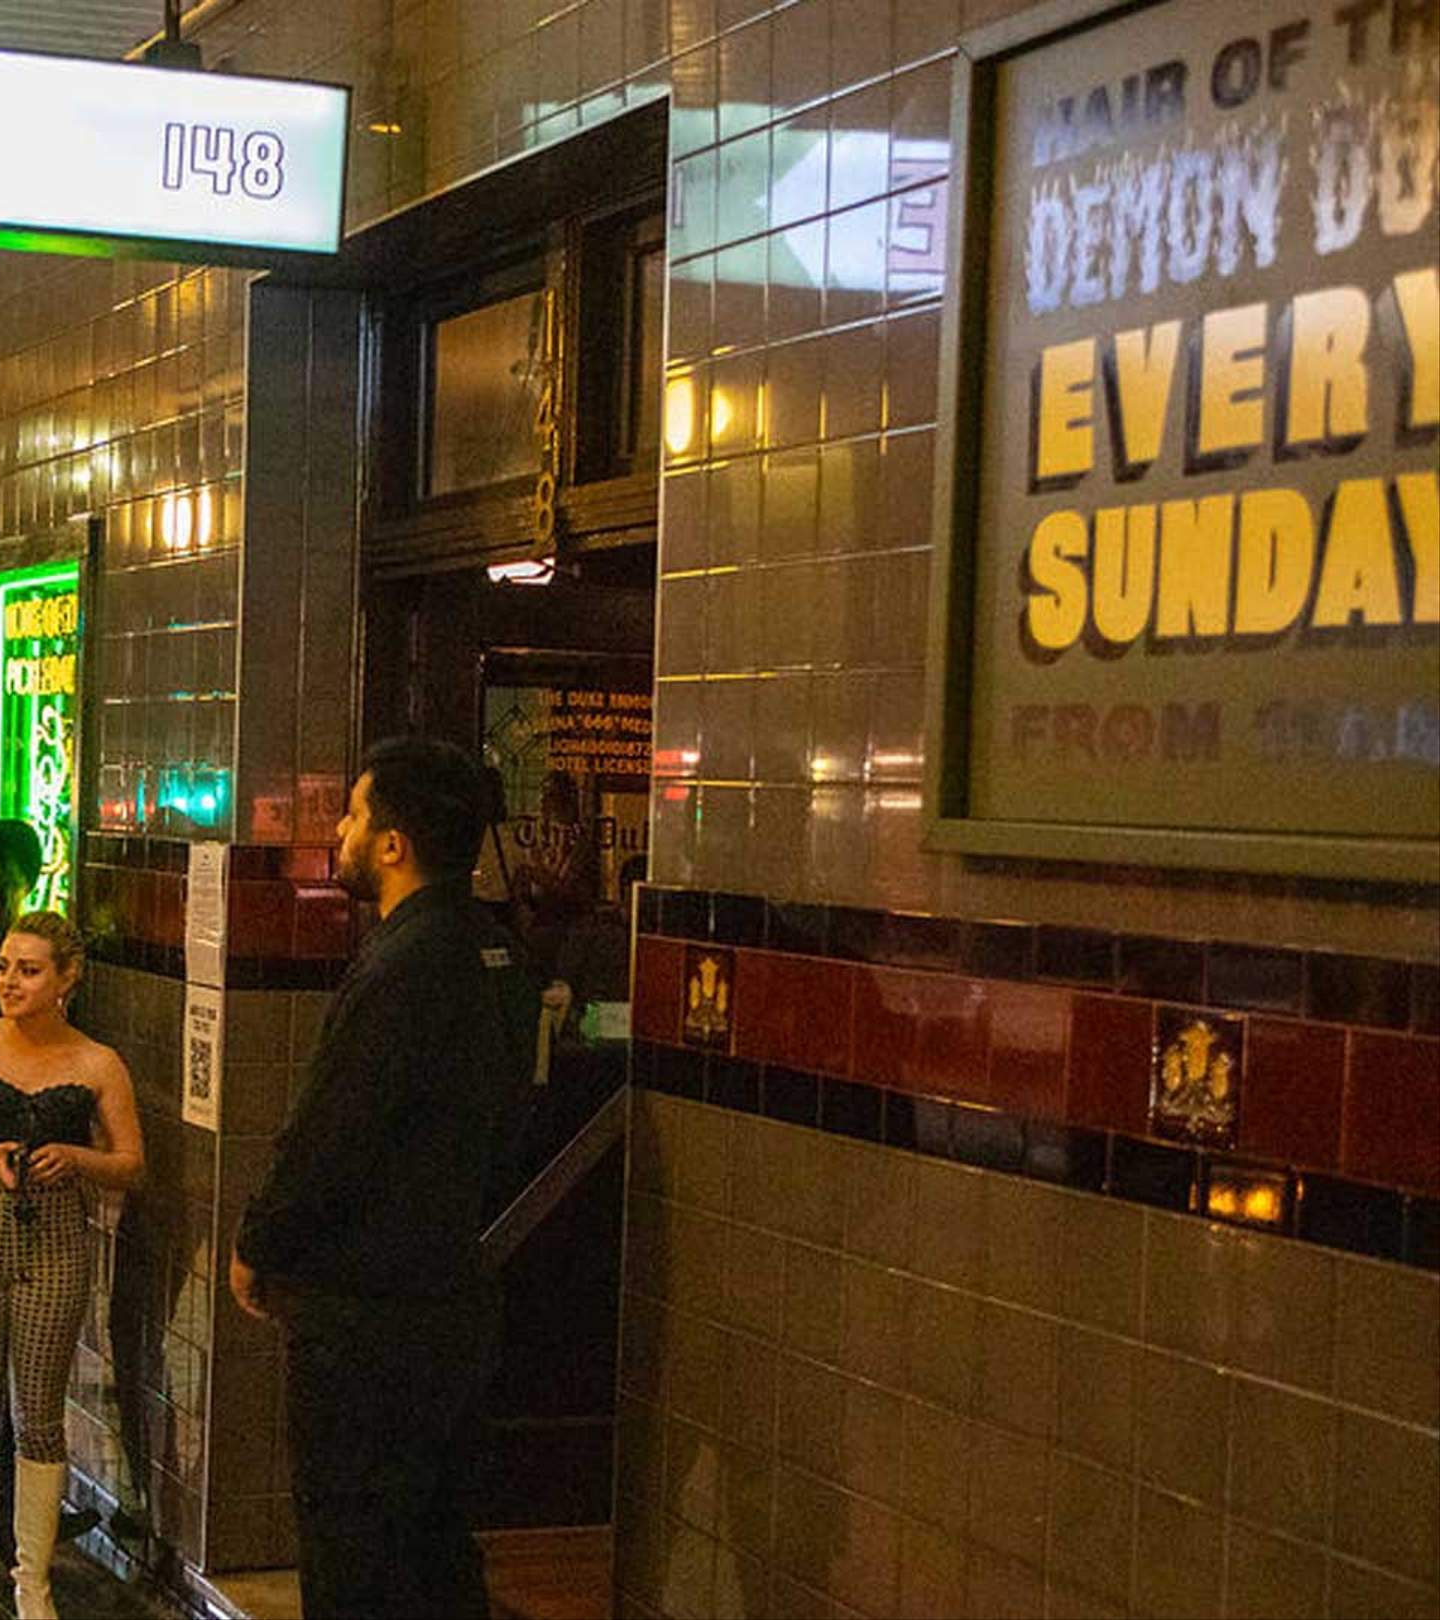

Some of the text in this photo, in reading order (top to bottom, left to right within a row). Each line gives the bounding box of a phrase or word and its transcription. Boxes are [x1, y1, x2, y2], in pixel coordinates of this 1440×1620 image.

[1209, 19, 1312, 110] OF
[162, 122, 284, 200] 148
[1026, 120, 1287, 317] DEMON
